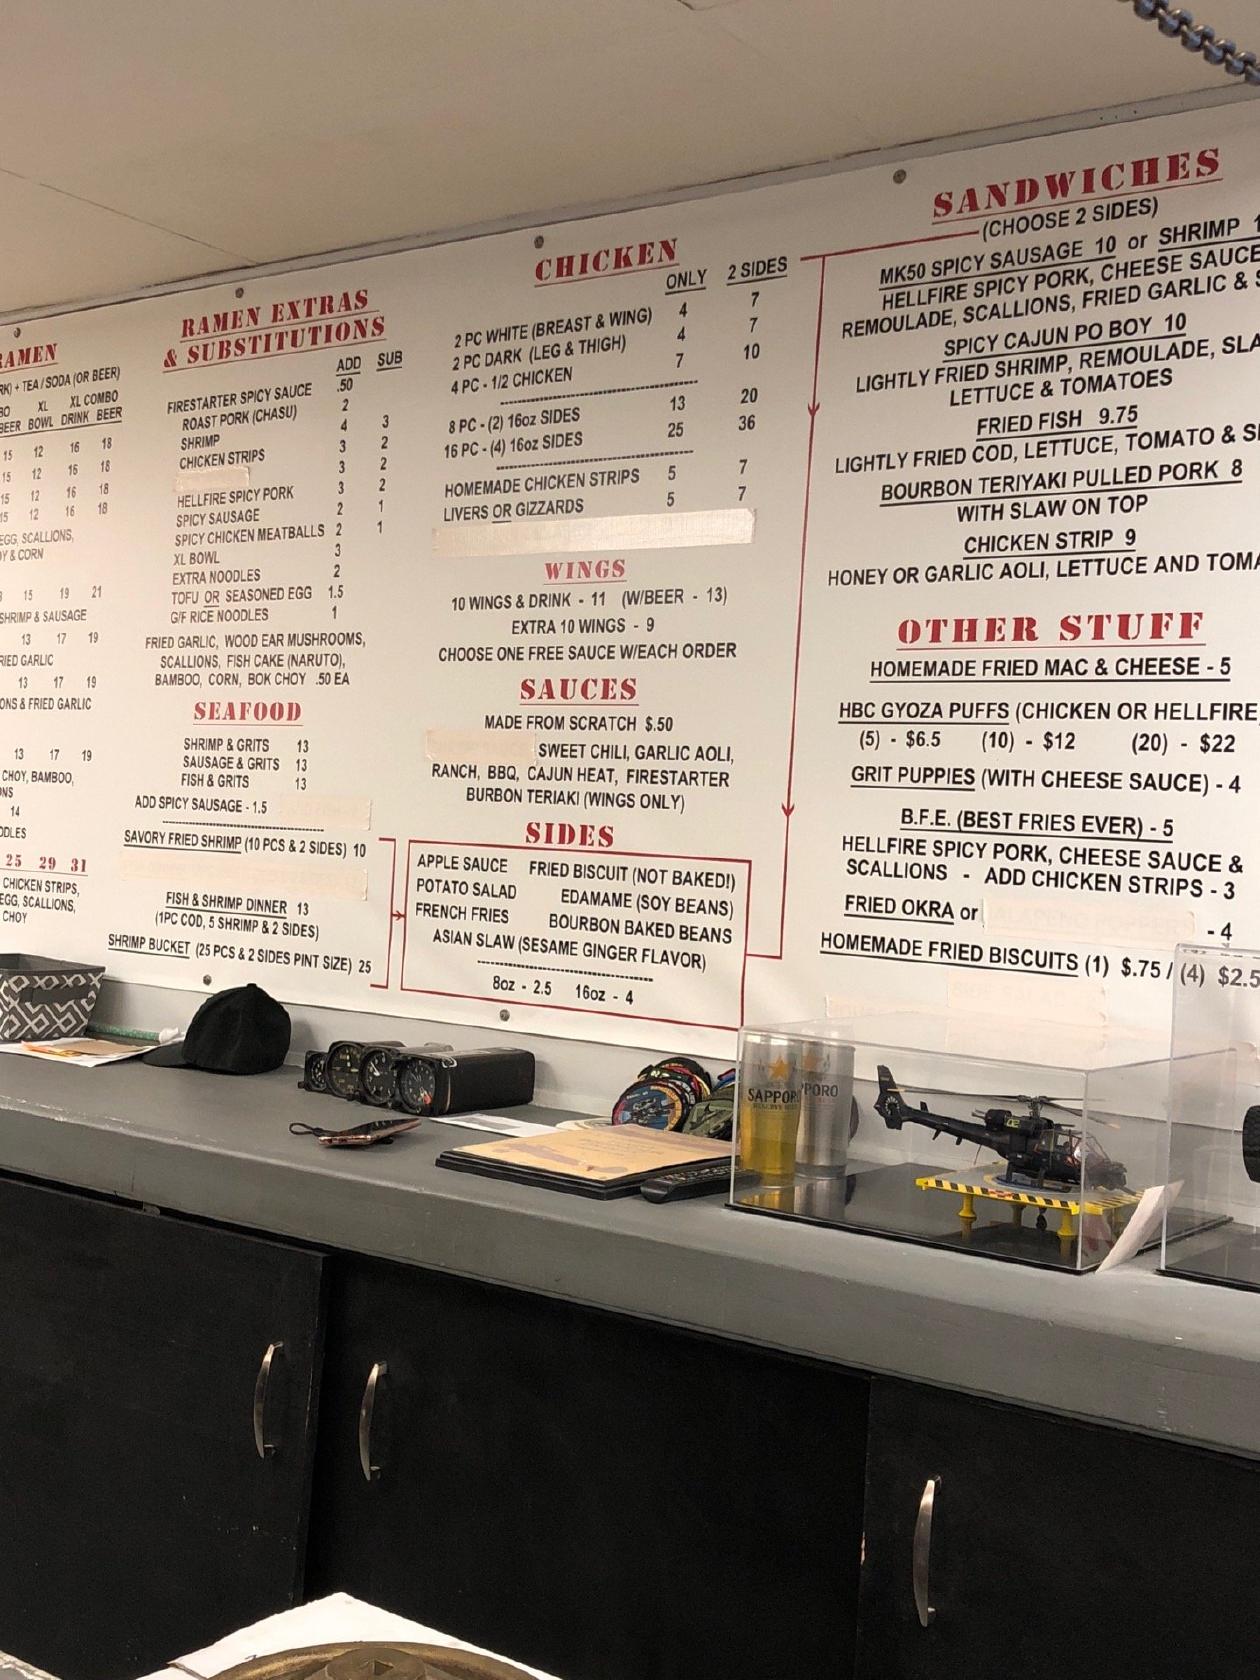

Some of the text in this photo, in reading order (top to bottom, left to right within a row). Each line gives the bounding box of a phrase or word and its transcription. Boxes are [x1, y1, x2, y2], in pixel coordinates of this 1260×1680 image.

[933, 148, 1219, 218] SANDWICHES
[983, 196, 1158, 242] (CHOOSE 2 SIDES)
[535, 238, 678, 281] CHICKEN
[666, 256, 787, 290] ONLY 2 SIDES
[182, 289, 368, 338] RAMEN EXTRAS
[454, 291, 760, 349] 2 PC WHITE (BREAST & WING) 4 7
[164, 316, 385, 368] & SUBSTITUTIONS
[944, 312, 1186, 357] SPICY CAJUN PO BOY 10
[336, 350, 403, 372] ADD SUB
[72, 366, 121, 386] (OR BEER)
[950, 368, 1173, 407] LETTUCE & TOMATOES
[38, 389, 119, 413] XL XL COMBO
[167, 377, 354, 415] FIRESTARTER SPICY SAUCE .50
[28, 406, 123, 431] BOWL DRINK BEER
[977, 404, 1138, 436] FRIED FISH 9.75
[181, 414, 389, 451] SHRIMP 4 3
[3, 437, 112, 461] 15 12 16 18
[445, 459, 748, 498] HOMEMADE CHICKEN STRIPS 5 7
[881, 459, 1243, 501] BOURBON TERIYAKI PULLED PORK 8
[178, 485, 294, 508] HELLFIRE SPICY PORK
[22, 528, 74, 544] SCALLIONS,
[175, 520, 383, 547] SPICY CHICKEN MEATBALLS 2 1
[10, 548, 44, 561] & CORN
[172, 564, 340, 586] EXTRA NOODLES 2
[545, 559, 625, 580] WINGS
[33, 609, 87, 623] & SAUSAGE
[898, 612, 1203, 644] OTHER STUFF
[146, 632, 366, 650] FRIED GARLIC, WOOD EAR MUSHROOMS,
[438, 642, 737, 662] CHOOSE ONE FREE SAUCE W/EACH ORDER
[520, 678, 636, 701] SAUCES
[19, 697, 92, 710] & FRIED GARLIC
[194, 702, 301, 721] SEAFOOD
[183, 755, 307, 772] SAUSAGE & GRITS 13
[538, 743, 587, 759] SWEET
[590, 744, 630, 762] CHILI,
[635, 744, 690, 761] GARLIC
[694, 746, 734, 765] AOLI,
[2, 770, 74, 785] CHOY, BAMBOO,
[851, 765, 1209, 796] GRIT PUPPIES (WITH CHEESE SAUCE)
[466, 787, 685, 814] BURBON TERIAKI (WINGS ONLY)
[124, 829, 367, 860] SAVORY FRIED SHRIMP (10 PCS & 2 SIDES) 10
[526, 822, 614, 848] SIDES
[6, 854, 86, 873] 25 29 31
[417, 854, 508, 873] APPLE SAUCE
[842, 835, 1243, 874] HELLFIRE SPICY PORK, CHEESE SAUCE &
[3, 877, 80, 897] CHICKEN STRIPS,
[23, 895, 76, 914] SCALLIONS,
[561, 888, 734, 921] EDAMAME (SOY BEANS)
[821, 932, 1078, 971] HOMEMADE FRIED BISCUITS
